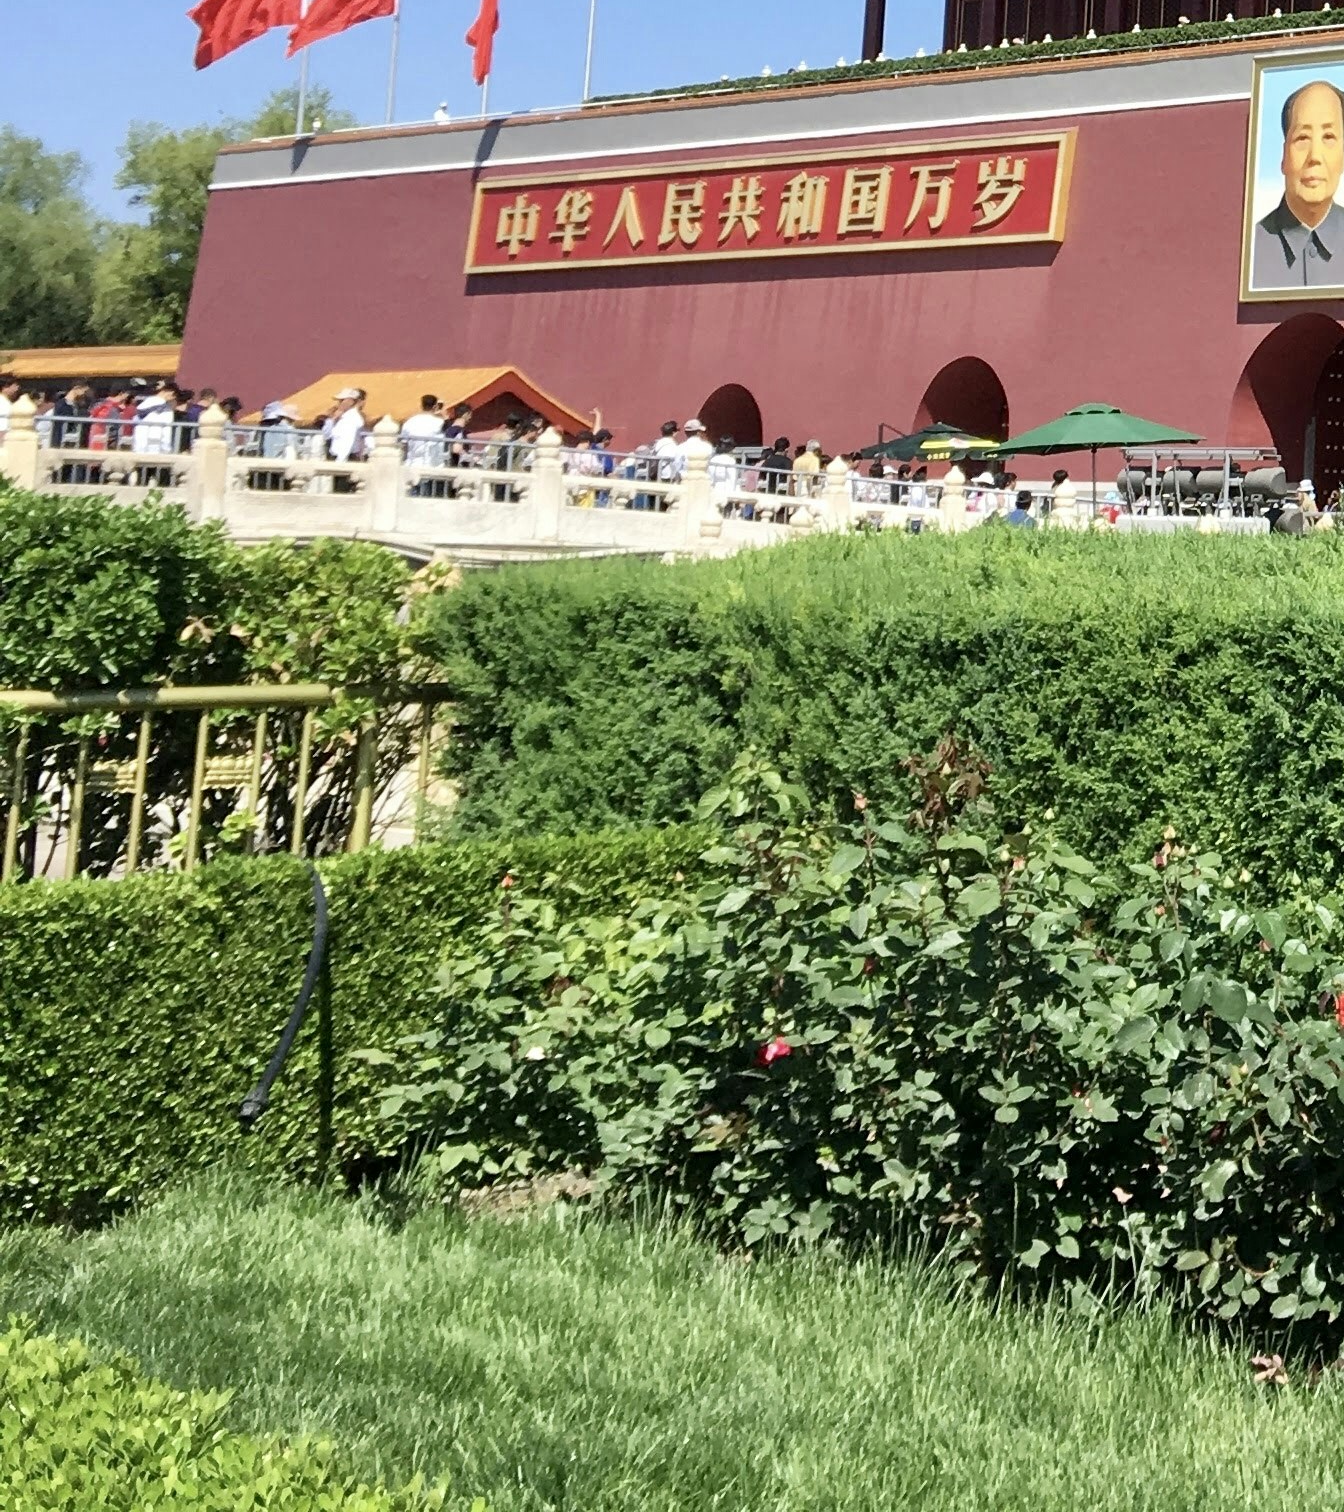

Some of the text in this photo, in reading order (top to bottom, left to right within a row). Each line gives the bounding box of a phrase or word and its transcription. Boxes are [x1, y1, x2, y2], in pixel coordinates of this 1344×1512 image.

[495, 158, 1027, 255] 中华人民共和国万岁
